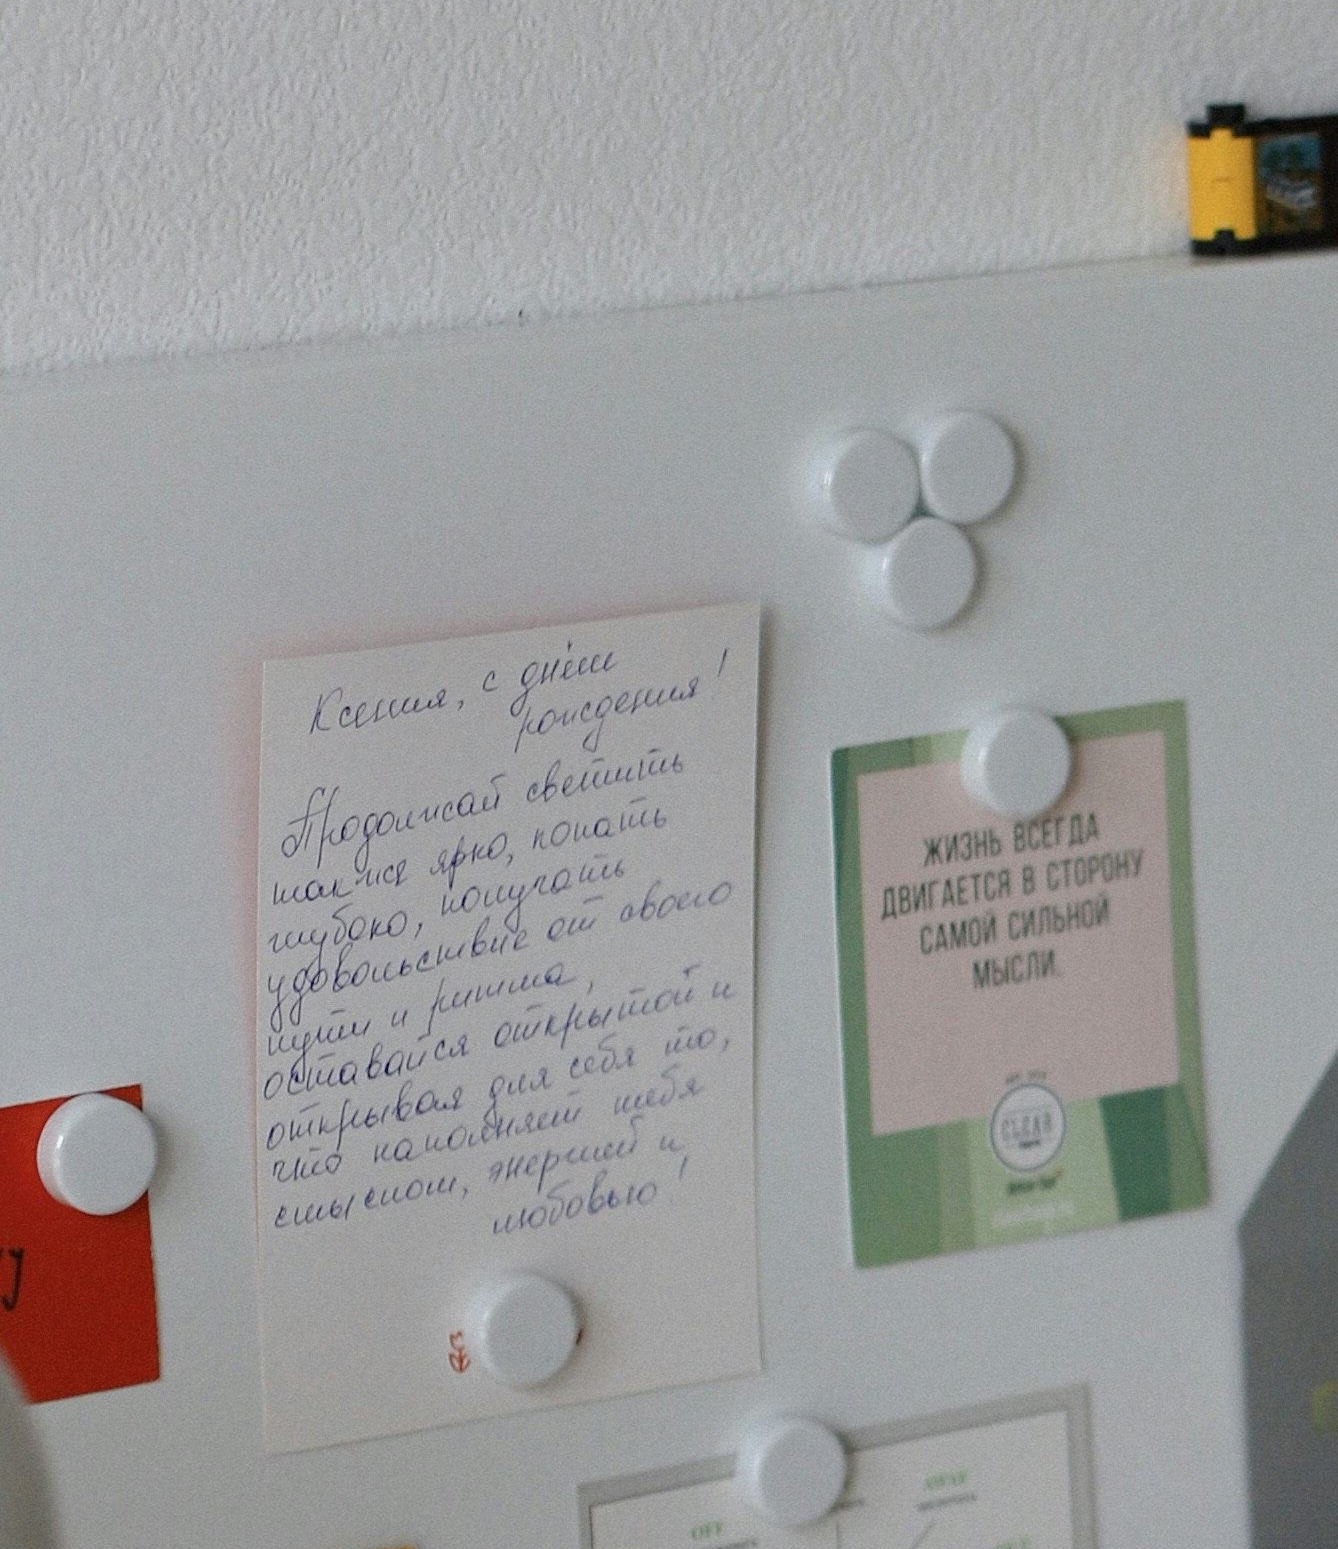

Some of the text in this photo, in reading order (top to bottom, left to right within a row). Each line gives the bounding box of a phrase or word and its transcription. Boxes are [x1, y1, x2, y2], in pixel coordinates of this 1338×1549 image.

[309, 686, 465, 734] Ксения,
[482, 669, 499, 692] с
[272, 796, 668, 906] так же ярко, копать
[280, 748, 684, 870] Продолжай светить
[923, 811, 1101, 867] ЖИЗНЬ ВСЕГДА
[267, 853, 626, 974] глубоко, получать
[880, 848, 1144, 921] ДВИГАЕТСЯ В СТОРОНУ
[919, 891, 1110, 955] САМОЙ СИЛЬНОЙ
[267, 879, 733, 1034] удовольствие от своего
[263, 963, 736, 1101] оставайся открытой и
[267, 962, 594, 1086] пути и ритма,
[266, 1025, 730, 1153] открывая для себя то,
[272, 1062, 705, 1182] что наполняет тебя
[274, 1113, 683, 1229] смыслом, энергией и
